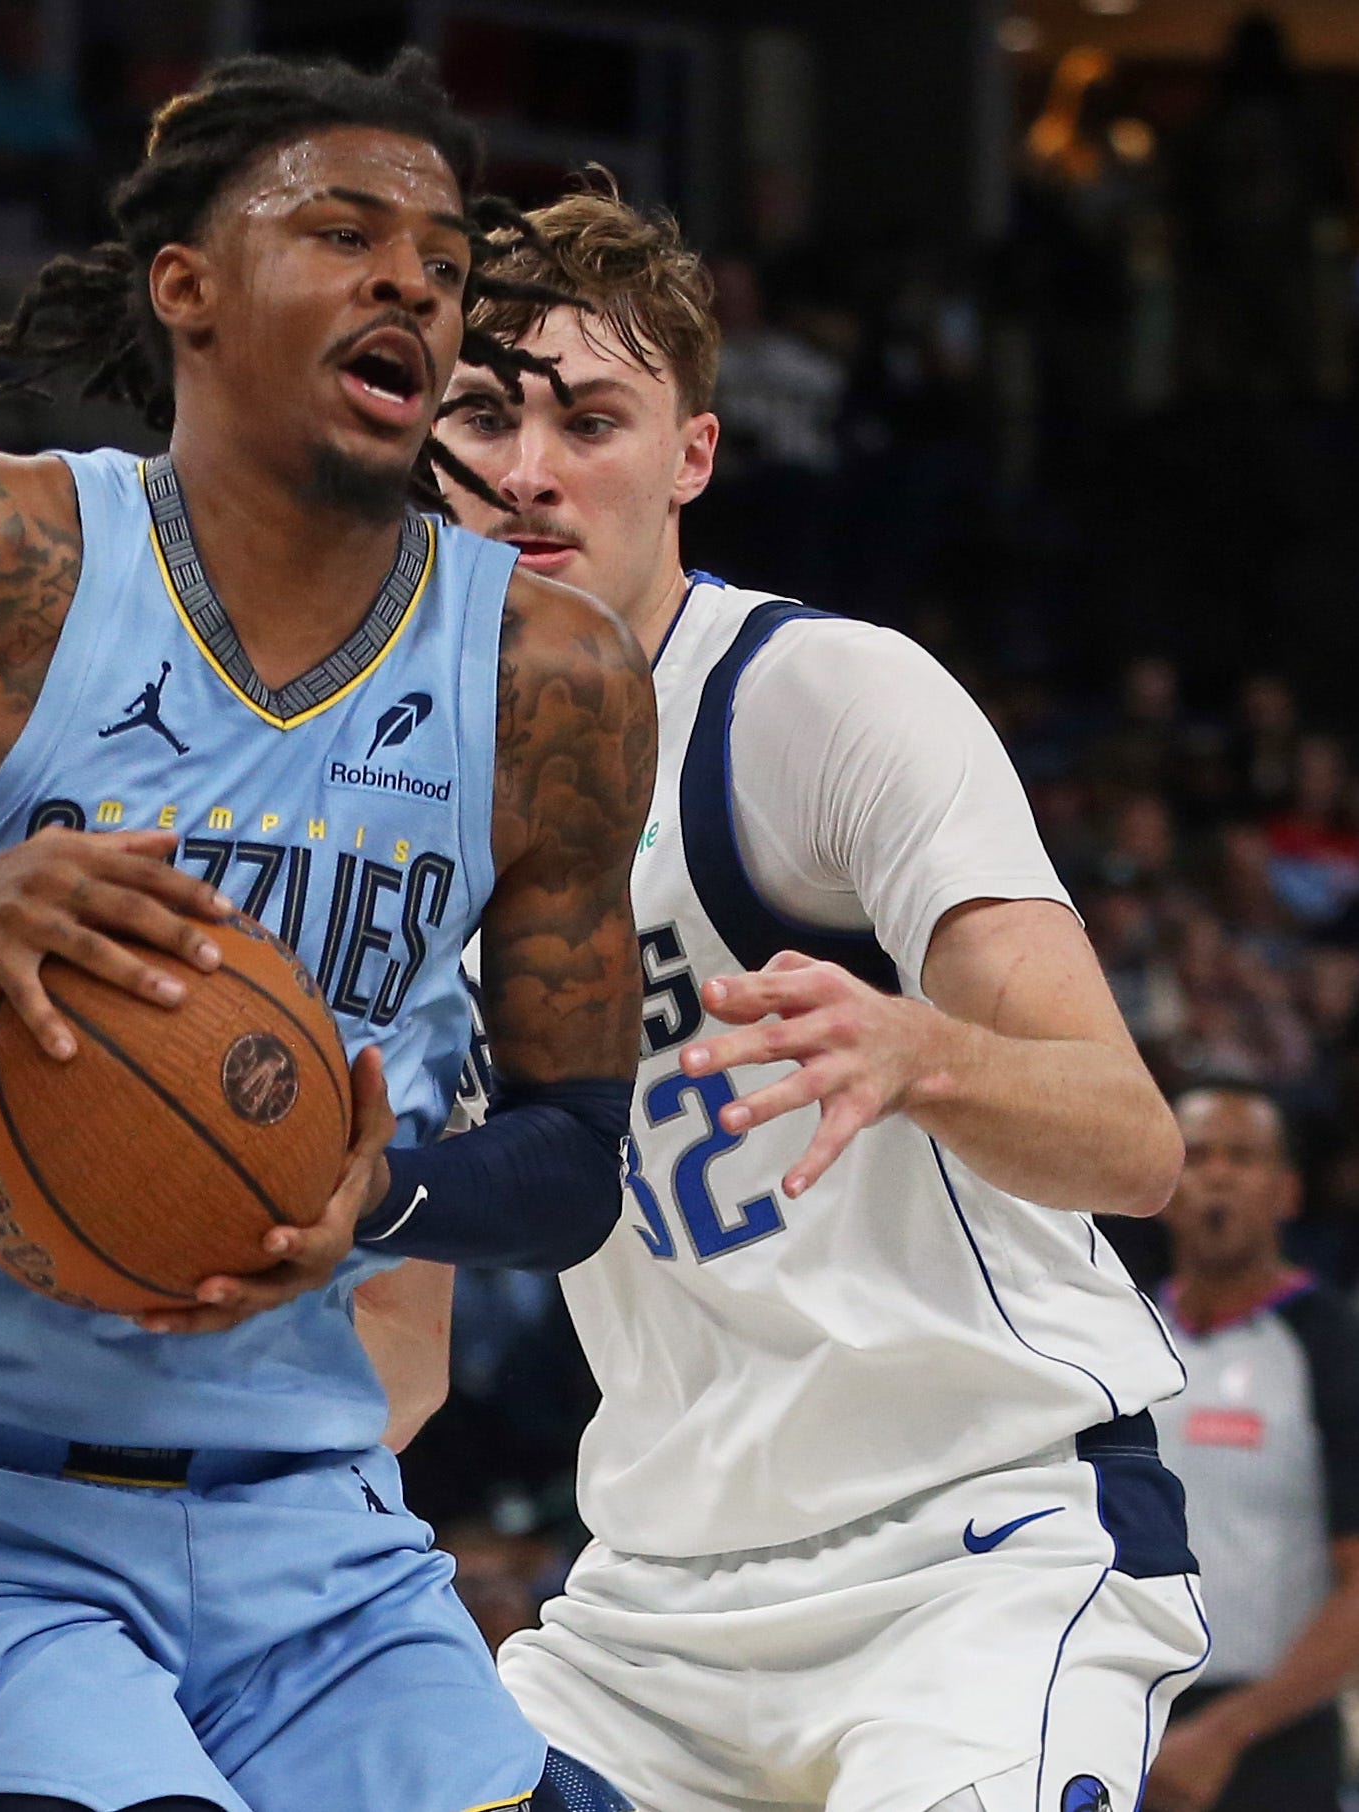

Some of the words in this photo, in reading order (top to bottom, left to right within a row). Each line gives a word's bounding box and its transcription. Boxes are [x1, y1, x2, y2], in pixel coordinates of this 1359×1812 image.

[330, 761, 451, 802] Robinhood
[96, 800, 410, 864] MEMPHIS
[25, 798, 456, 1028] ZLIES
